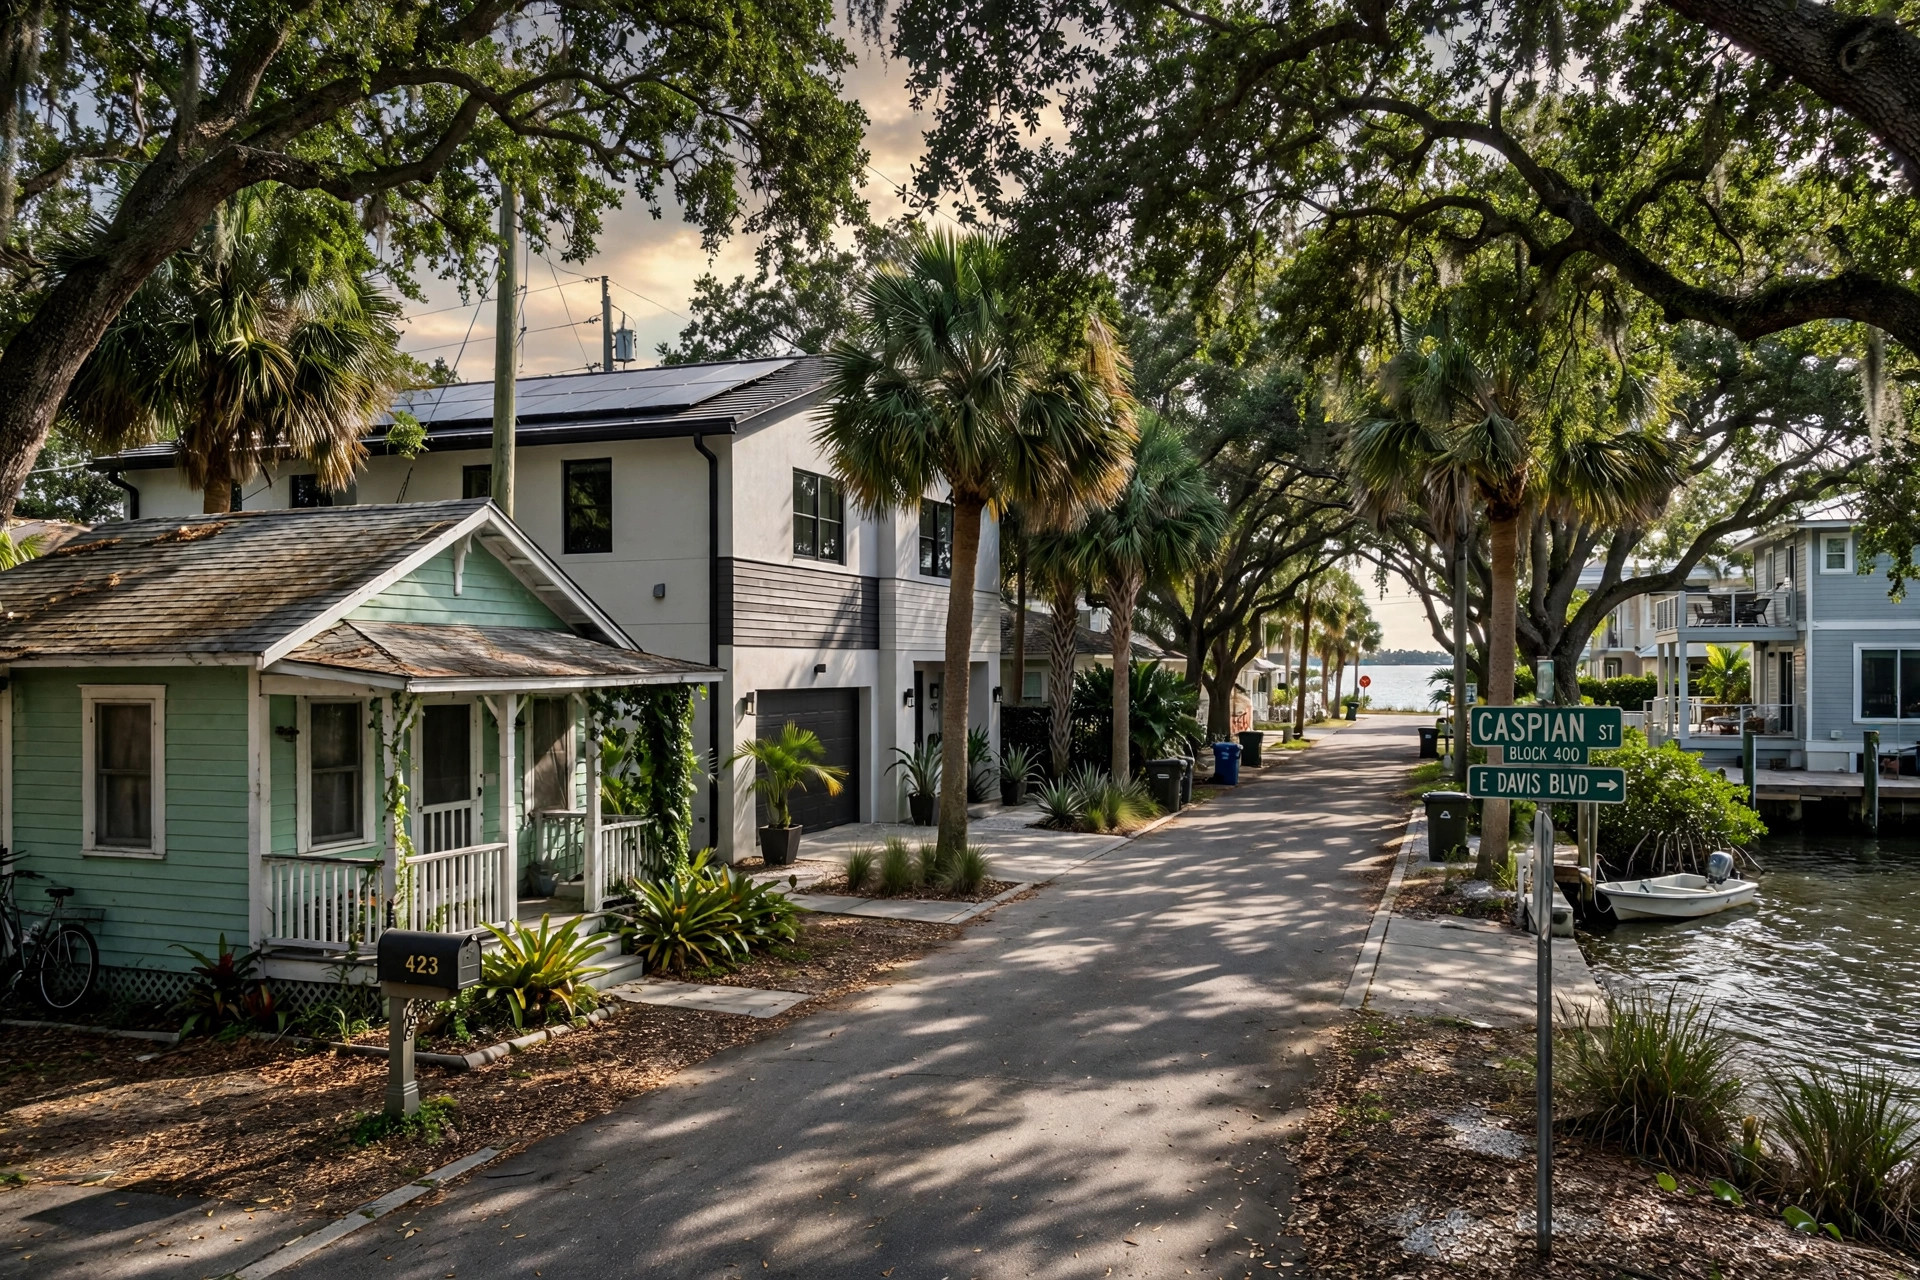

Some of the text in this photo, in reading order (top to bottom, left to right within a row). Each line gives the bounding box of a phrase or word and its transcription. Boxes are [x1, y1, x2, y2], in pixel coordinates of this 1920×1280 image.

[1478, 712, 1615, 743] CASPIAN ST
[1509, 746, 1580, 762] BLOCK 400
[1479, 771, 1589, 795] E DAVIS BLVD
[405, 955, 439, 975] 423
